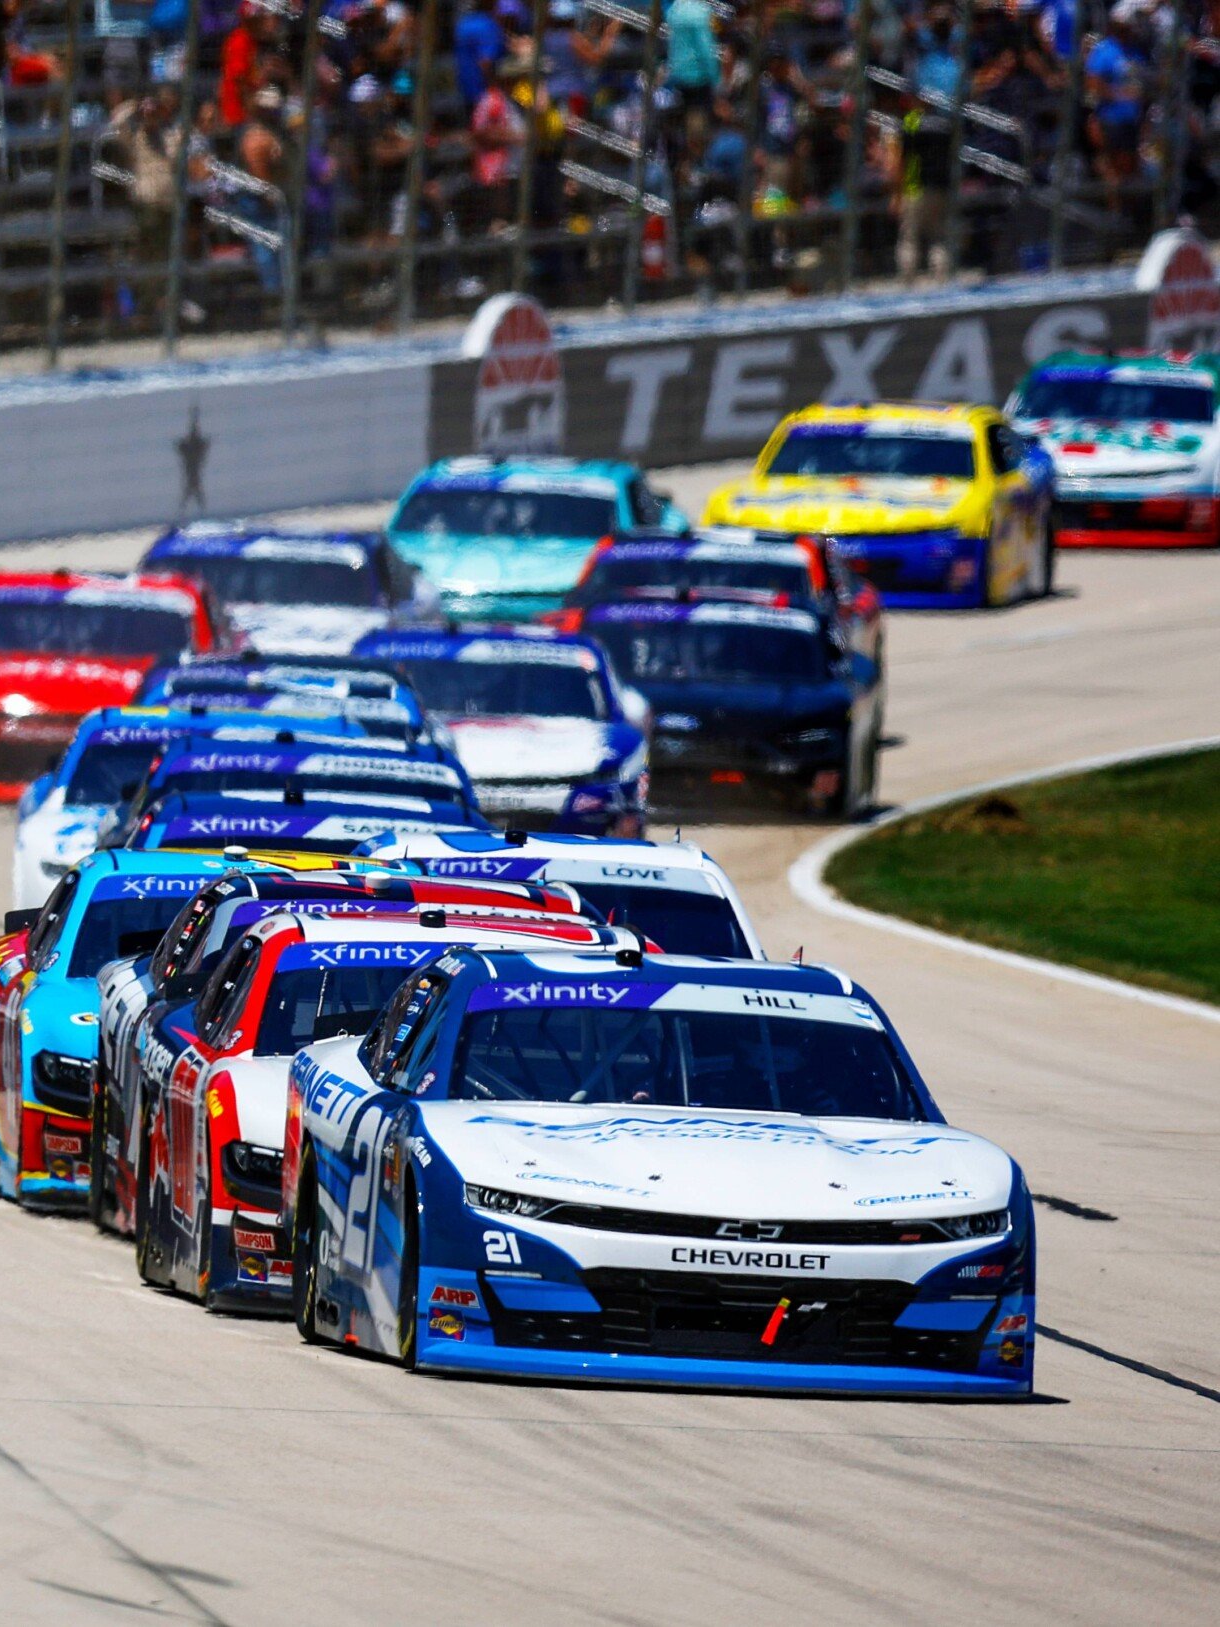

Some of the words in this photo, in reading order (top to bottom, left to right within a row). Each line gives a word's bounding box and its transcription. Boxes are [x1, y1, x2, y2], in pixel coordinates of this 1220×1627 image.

[188, 814, 291, 834] xfinity
[602, 866, 667, 881] LOVE
[309, 944, 432, 966] xfinity
[503, 979, 631, 1004] xfinity
[742, 992, 808, 1012] HILL
[868, 1190, 974, 1206] BENNETT
[482, 1229, 522, 1265] 21
[670, 1247, 831, 1270] CHEVROLET
[431, 1286, 477, 1306] ARP
